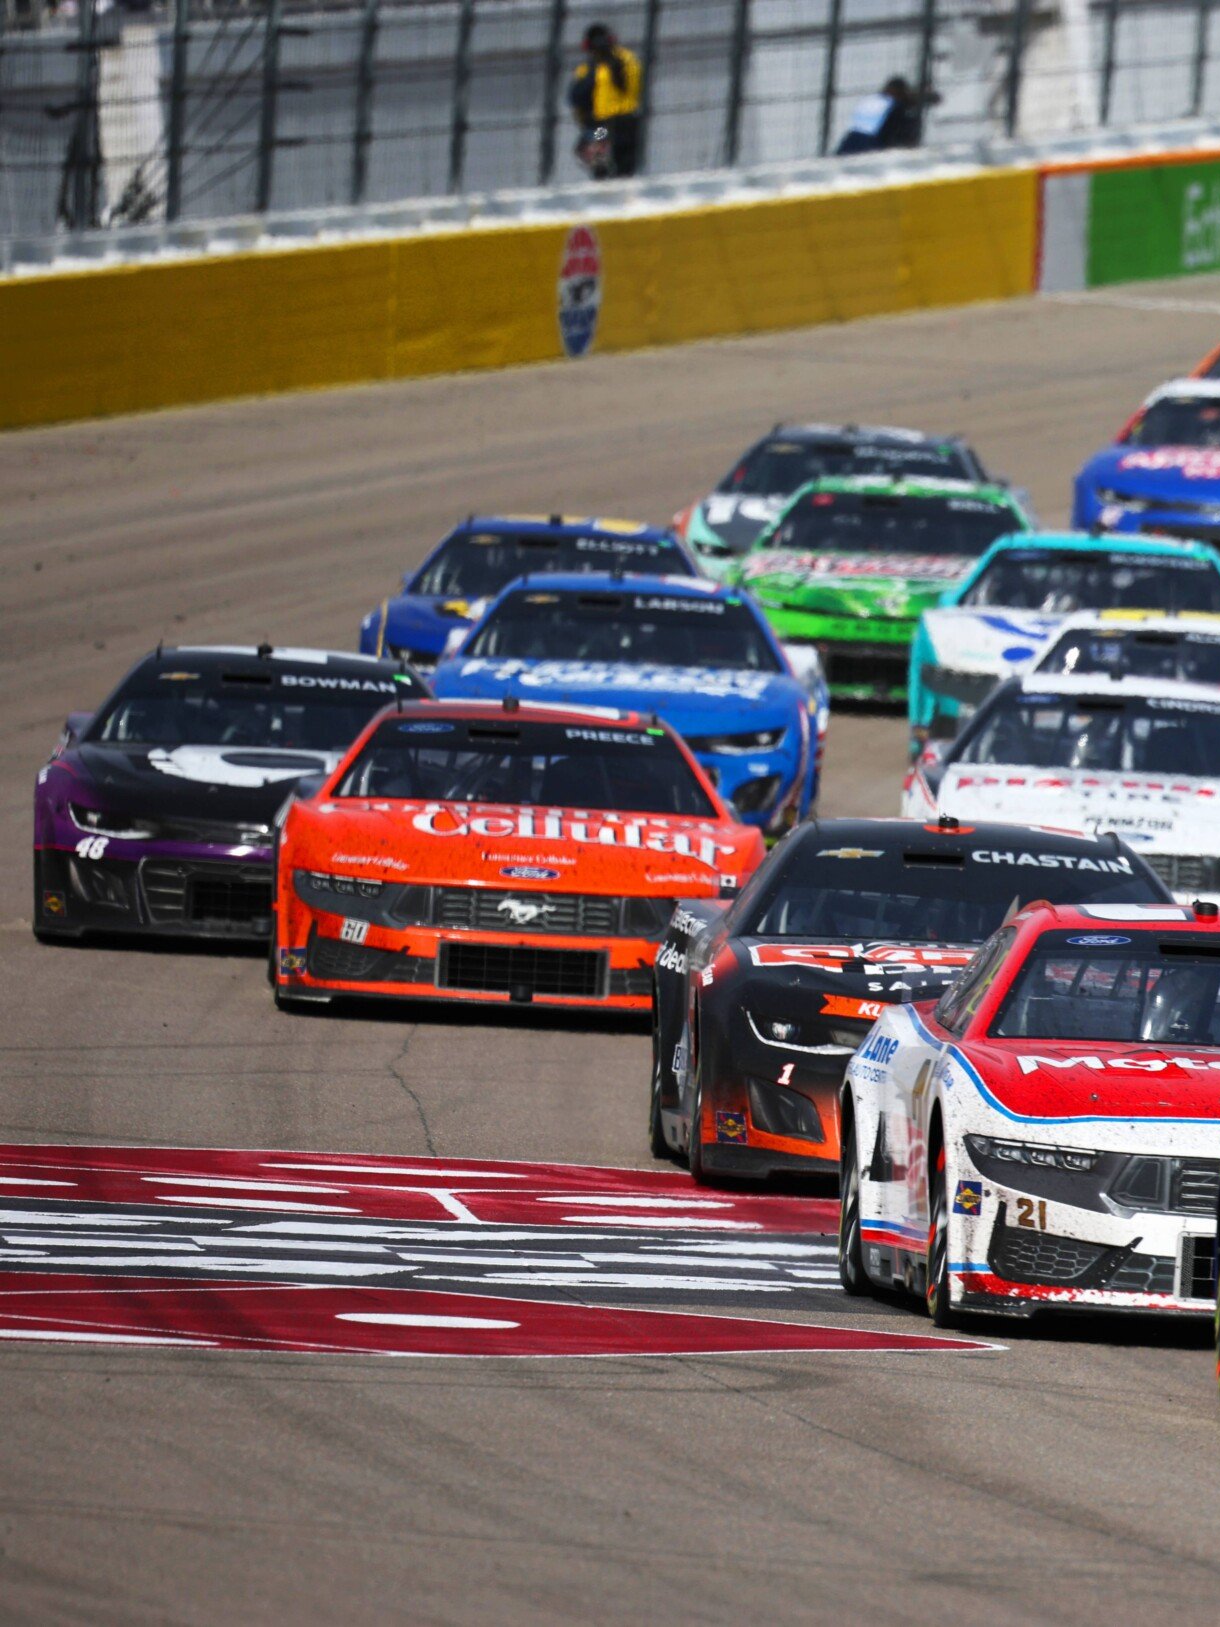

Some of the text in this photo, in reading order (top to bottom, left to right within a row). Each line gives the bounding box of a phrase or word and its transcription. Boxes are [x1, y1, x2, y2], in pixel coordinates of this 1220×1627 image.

[281, 674, 398, 694] BOWMAN
[565, 728, 656, 746] PREECE
[75, 836, 109, 860] 48
[411, 812, 737, 868] Cellular
[971, 849, 1133, 875] CHASTAIN
[339, 917, 370, 945] 60
[777, 1062, 795, 1086] 1
[1017, 1197, 1047, 1230] 21
